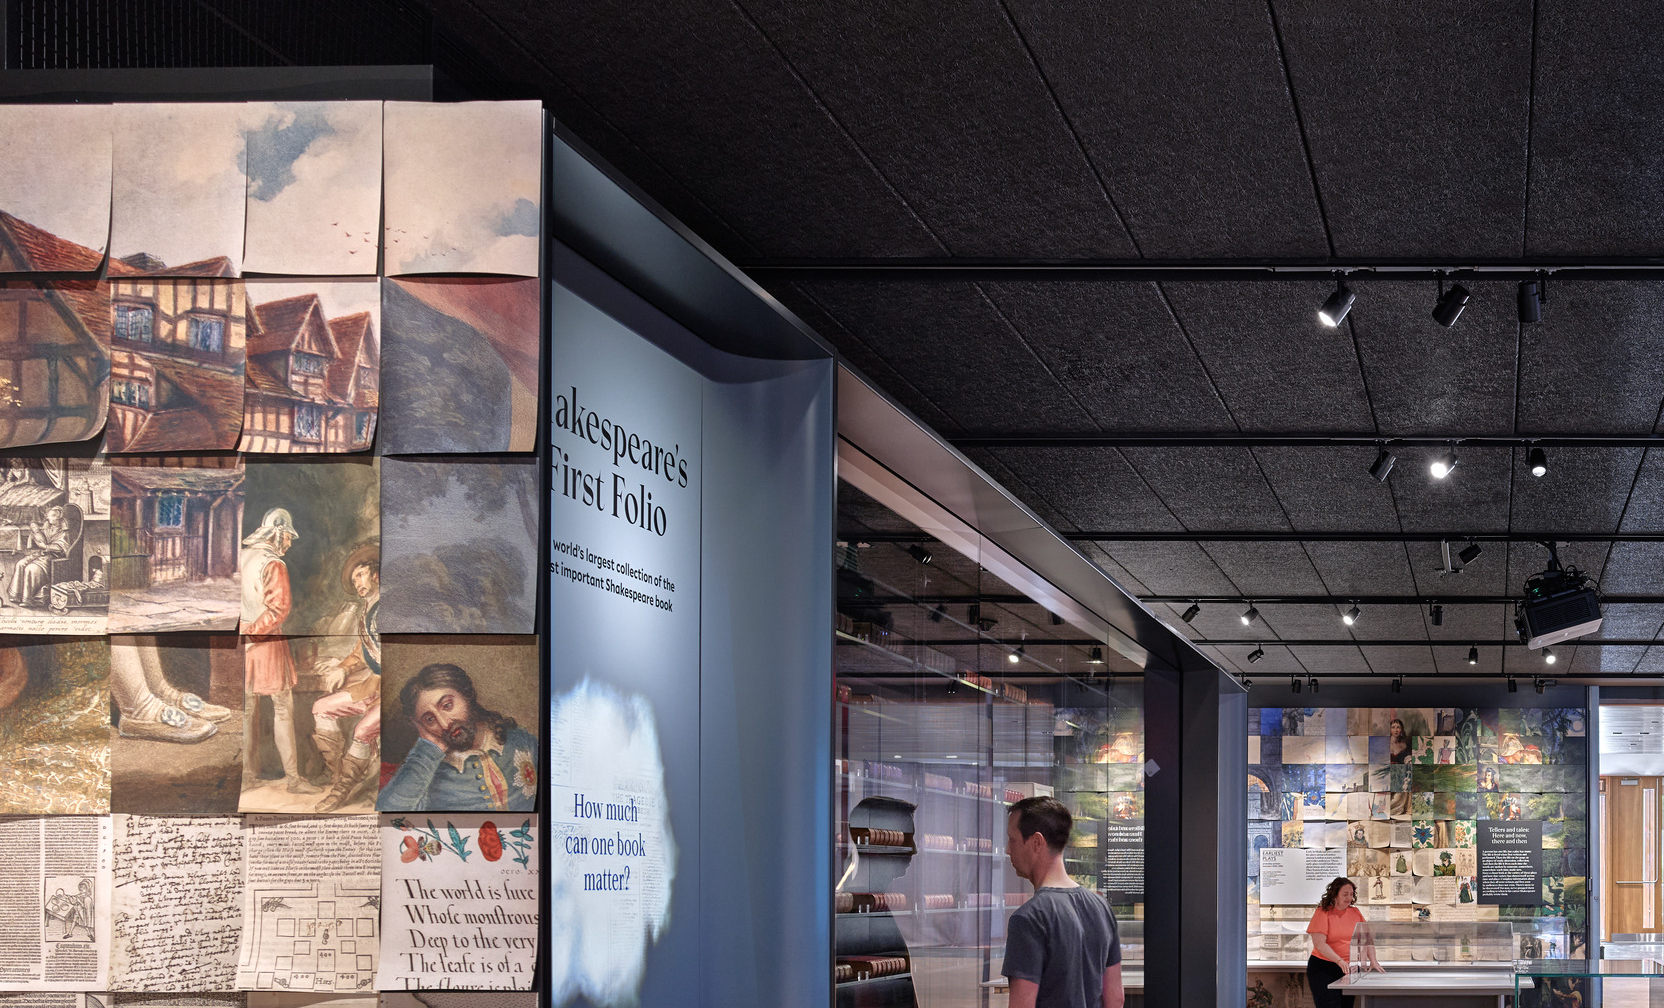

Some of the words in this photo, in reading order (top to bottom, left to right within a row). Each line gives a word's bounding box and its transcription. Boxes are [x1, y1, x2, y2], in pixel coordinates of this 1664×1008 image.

[552, 386, 688, 488] akespeare's
[551, 444, 604, 512] First
[611, 472, 667, 537] Folio
[553, 539, 585, 560] world's
[585, 547, 615, 571] largest
[616, 561, 653, 585] collection
[654, 570, 662, 587] of
[662, 573, 675, 593] the
[550, 561, 560, 576] st
[560, 564, 604, 590] important
[605, 578, 654, 606] Shakespeare
[655, 594, 673, 613] book
[574, 793, 603, 819] How
[606, 798, 638, 822] much
[565, 834, 588, 855] can
[591, 837, 614, 856] one
[617, 831, 646, 857] book
[396, 878, 436, 900] The
[440, 879, 485, 900] world
[488, 886, 501, 900] is
[584, 865, 631, 891] matter?
[406, 928, 448, 958] Deep
[452, 934, 469, 949] to
[473, 927, 501, 949] the
[503, 936, 536, 958] very
[400, 952, 437, 973] The
[481, 957, 493, 973] is
[498, 951, 512, 973] of
[514, 962, 524, 973] a
